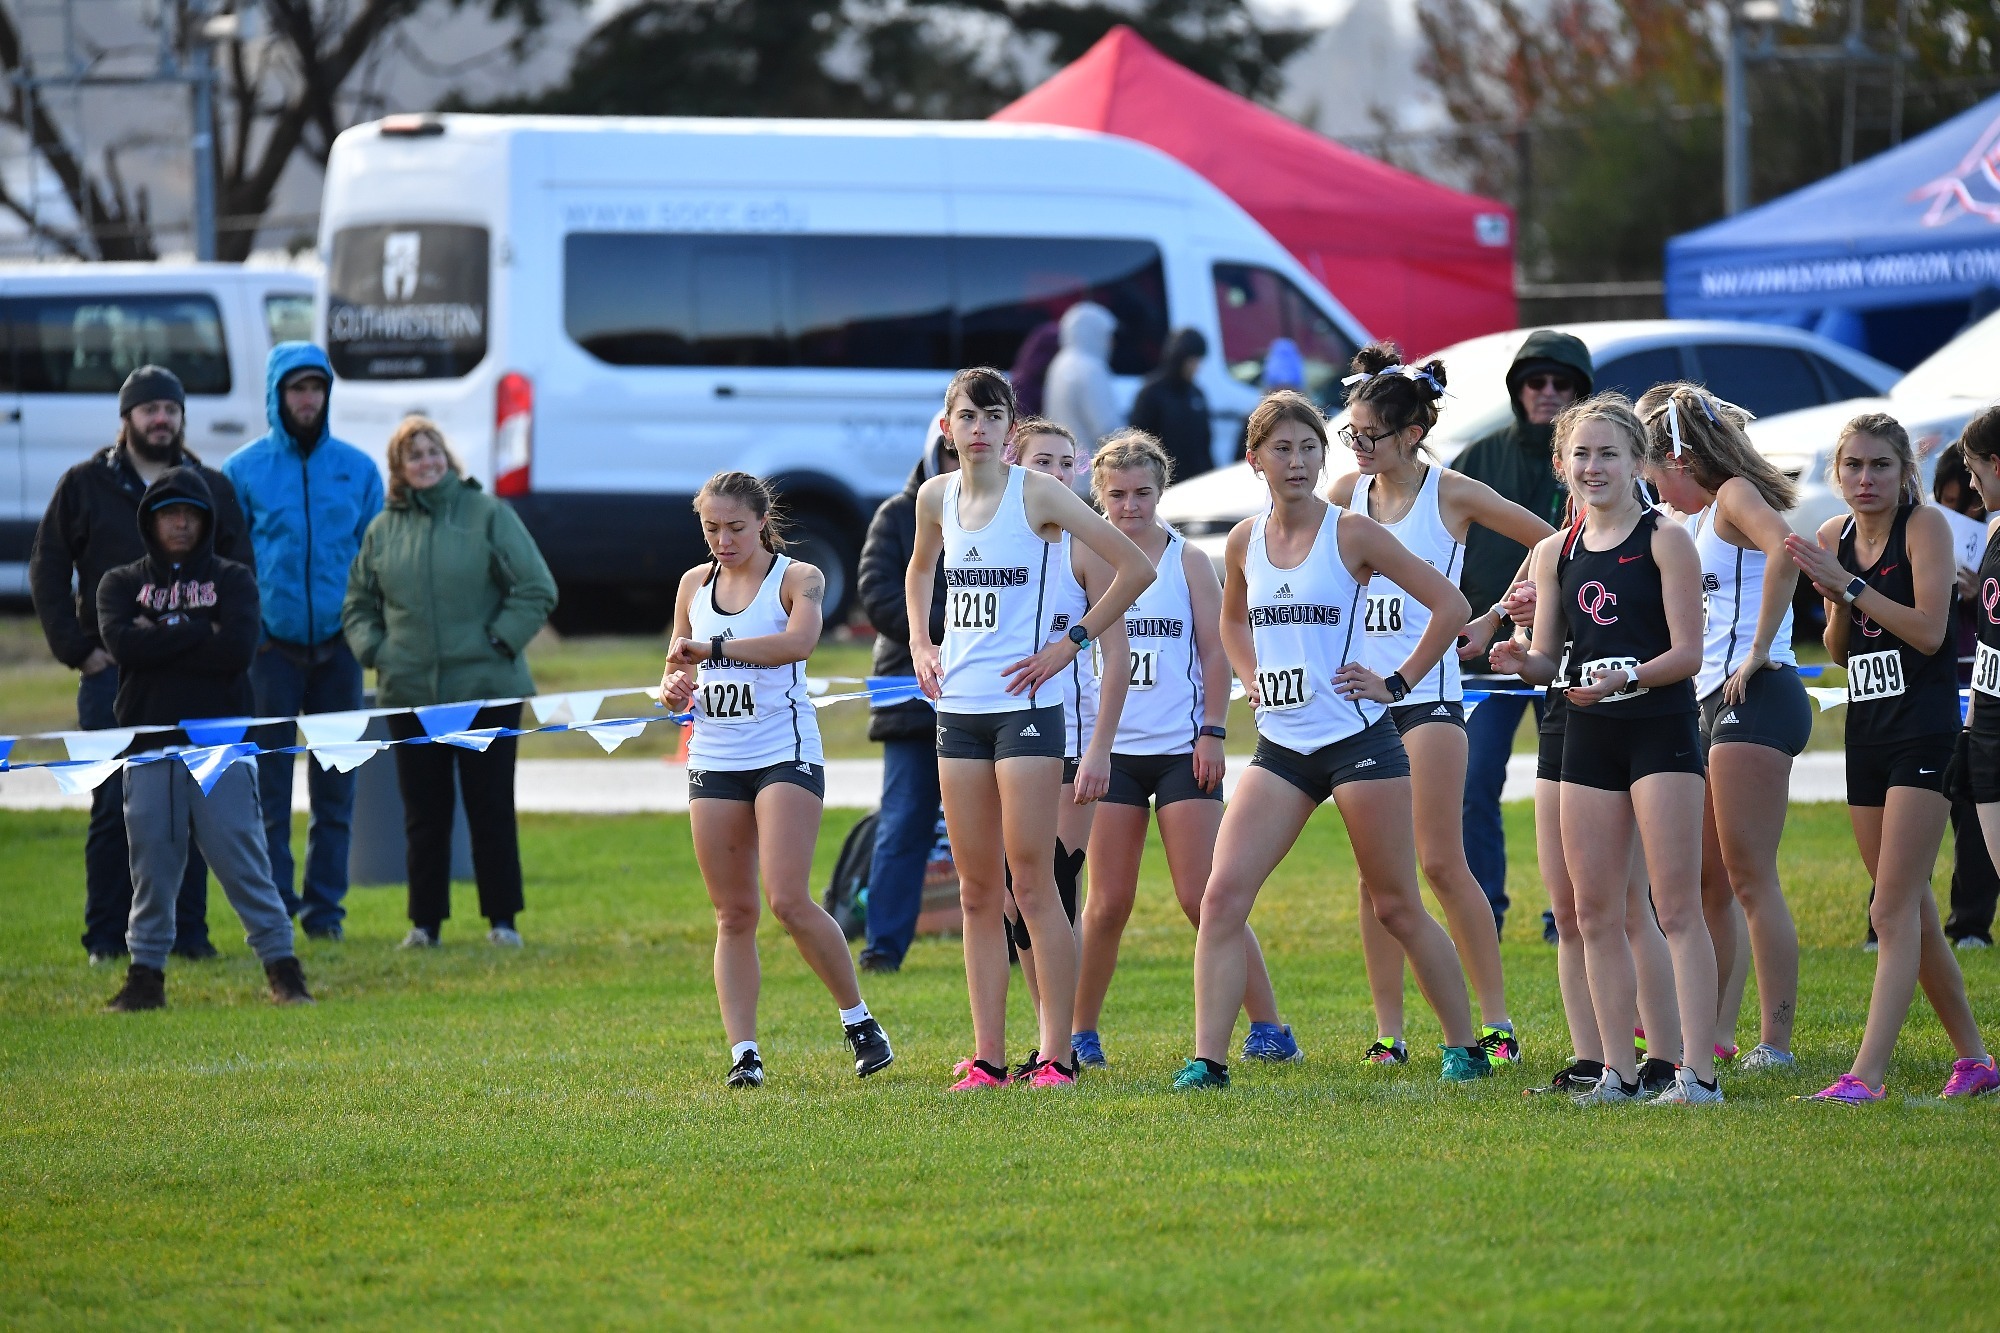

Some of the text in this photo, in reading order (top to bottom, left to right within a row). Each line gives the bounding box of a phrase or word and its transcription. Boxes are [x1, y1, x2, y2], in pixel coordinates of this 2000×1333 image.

[944, 567, 1029, 588] ENGUINS
[953, 592, 997, 628] 1219
[1364, 598, 1402, 632] 218
[1578, 581, 1618, 625] OC
[1125, 618, 1184, 638] GUINS
[1130, 652, 1153, 686] 21
[1850, 654, 1900, 697] 1299
[1976, 648, 2000, 691] 30
[703, 684, 755, 718] 1224
[1258, 667, 1305, 707] 1227
